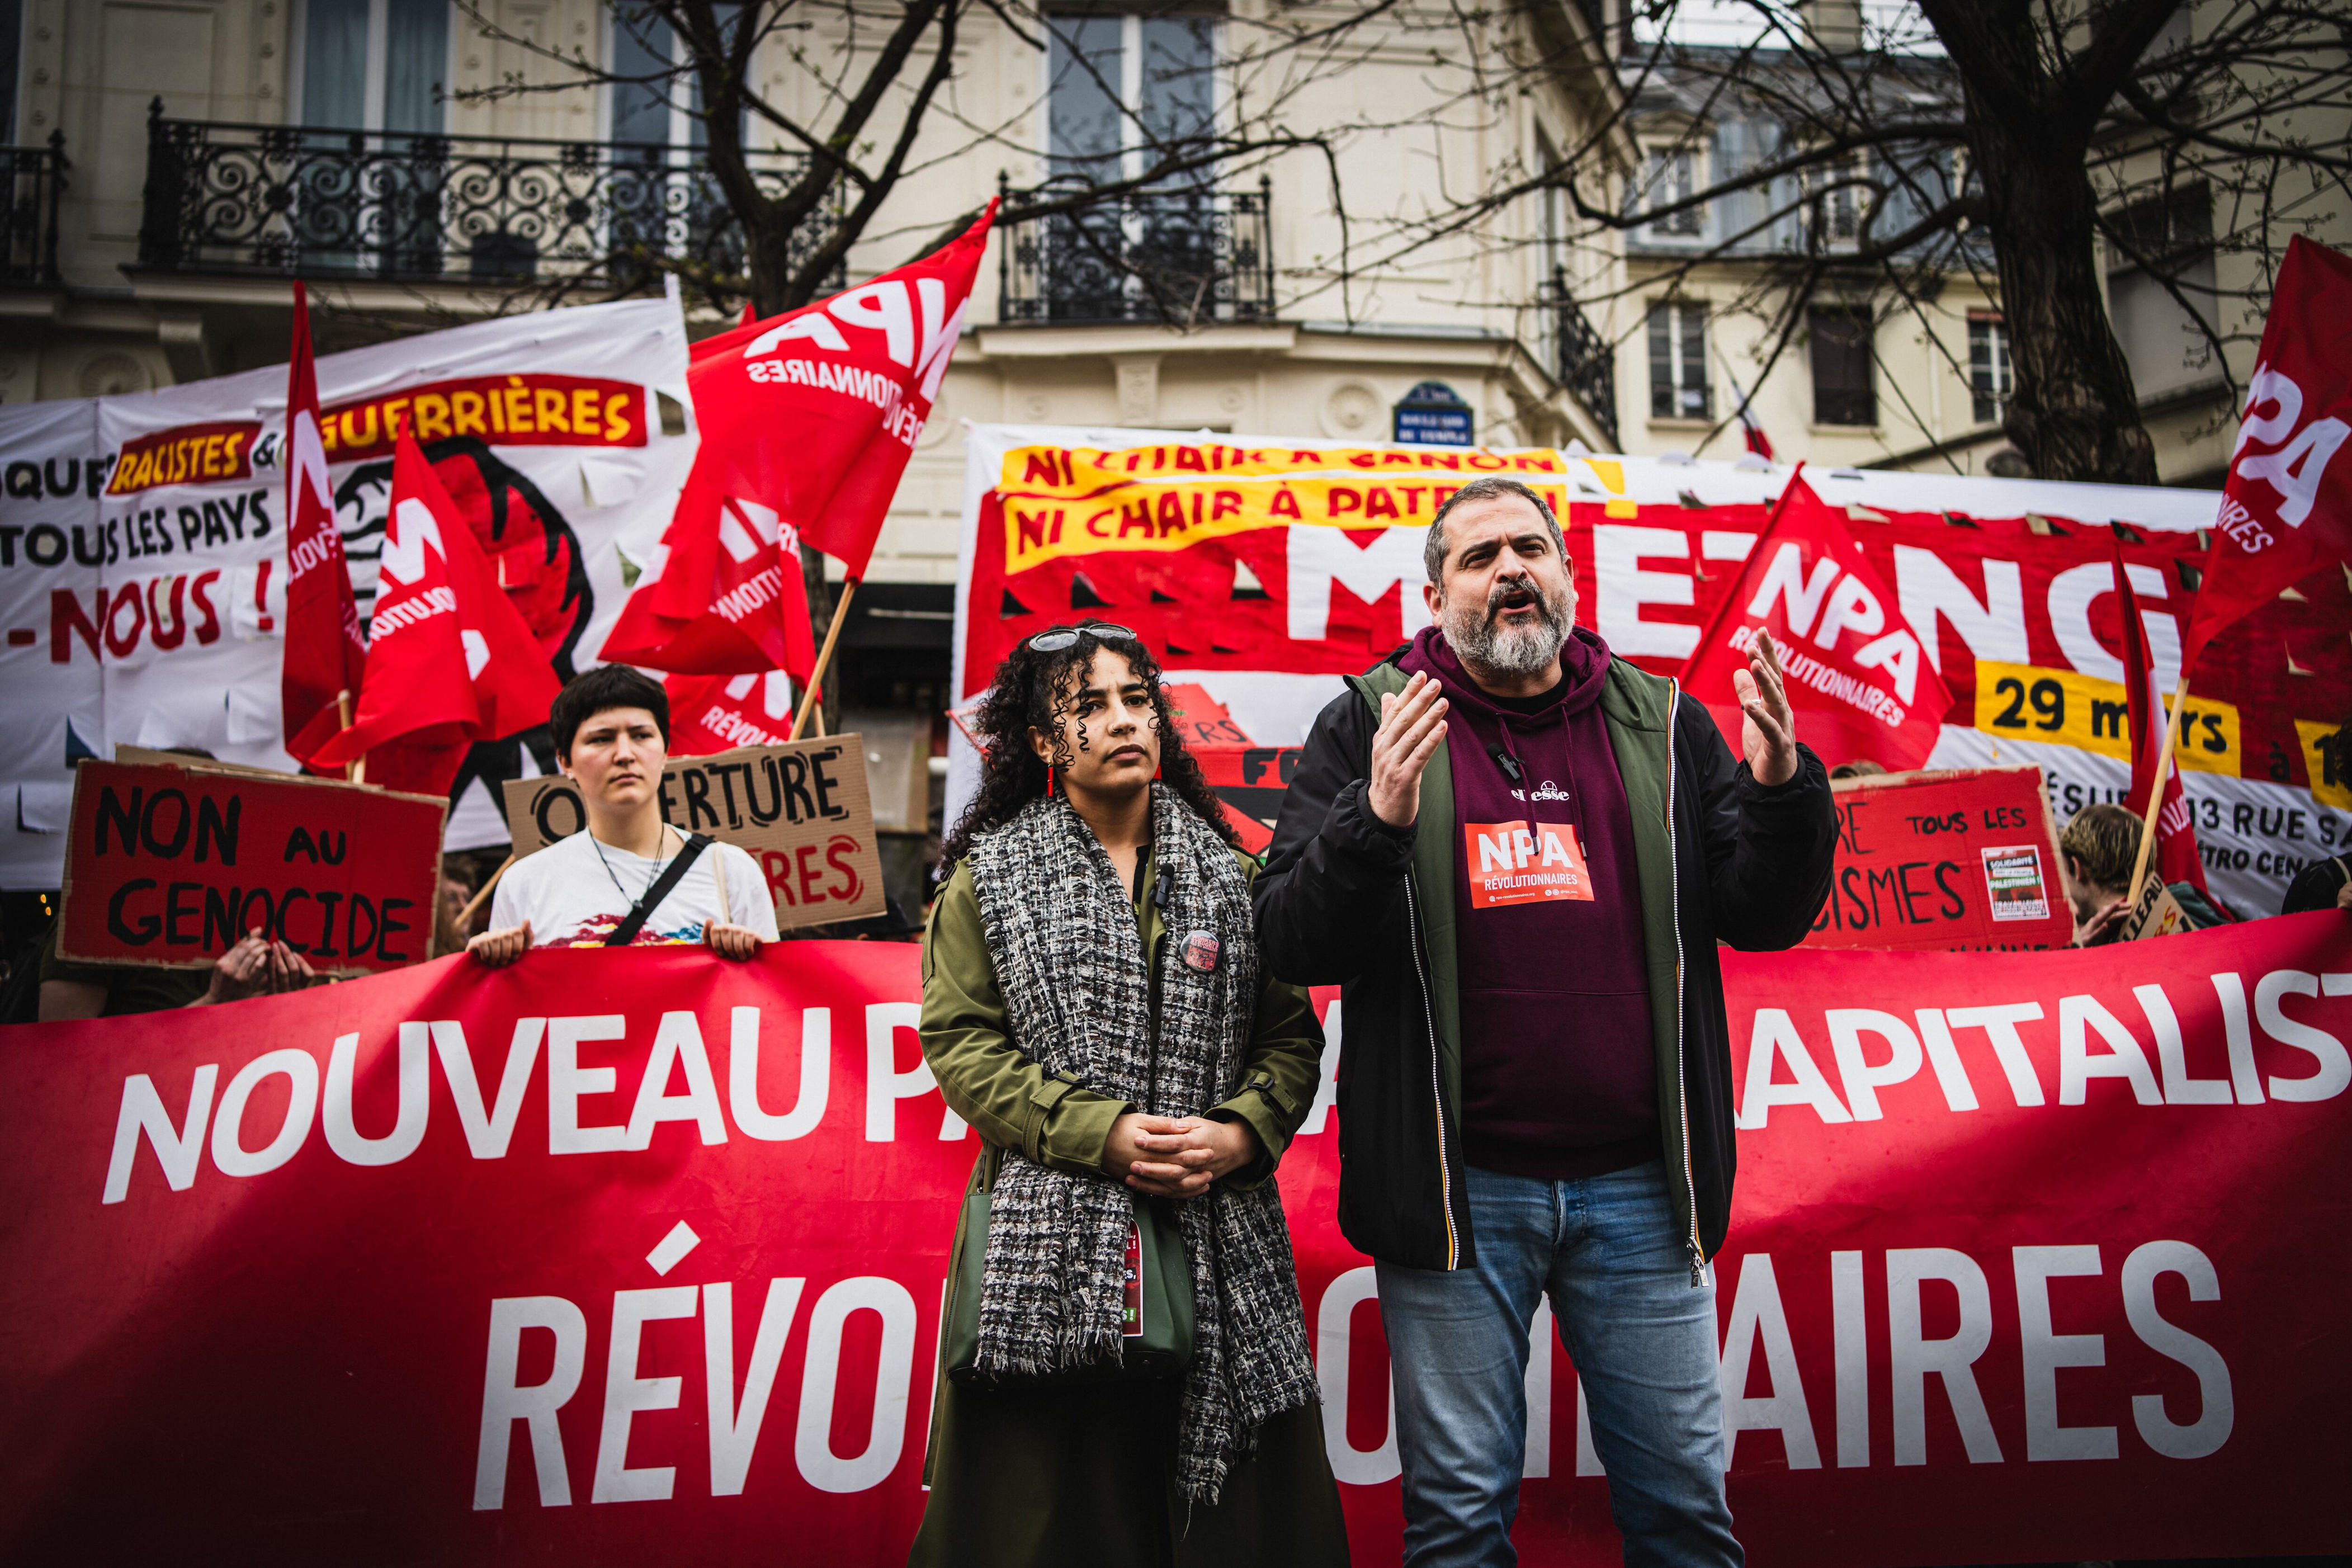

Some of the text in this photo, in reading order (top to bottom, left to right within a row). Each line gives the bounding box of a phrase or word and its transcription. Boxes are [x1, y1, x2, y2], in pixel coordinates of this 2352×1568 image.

[112, 431, 245, 493] RACISTES
[1024, 450, 1074, 487] NI
[0, 489, 272, 568] TOUS LES PAYS
[1017, 509, 1065, 555] NI
[1086, 490, 1243, 539] CHAIR
[1268, 481, 1301, 519] À
[1746, 542, 1920, 708] NPA
[1992, 677, 2066, 731] 29
[2091, 698, 2227, 754] mrs
[94, 785, 347, 866] NON AU
[1477, 829, 1574, 873] NPA
[1905, 811, 1969, 835] TOUS
[1983, 806, 2027, 830] LES
[2233, 801, 2306, 839] RUE
[108, 877, 414, 961] GENOCIDE
[1485, 873, 1578, 891] RÉVOLUTIONNAIRES
[102, 1005, 832, 1205] NOUVEAU
